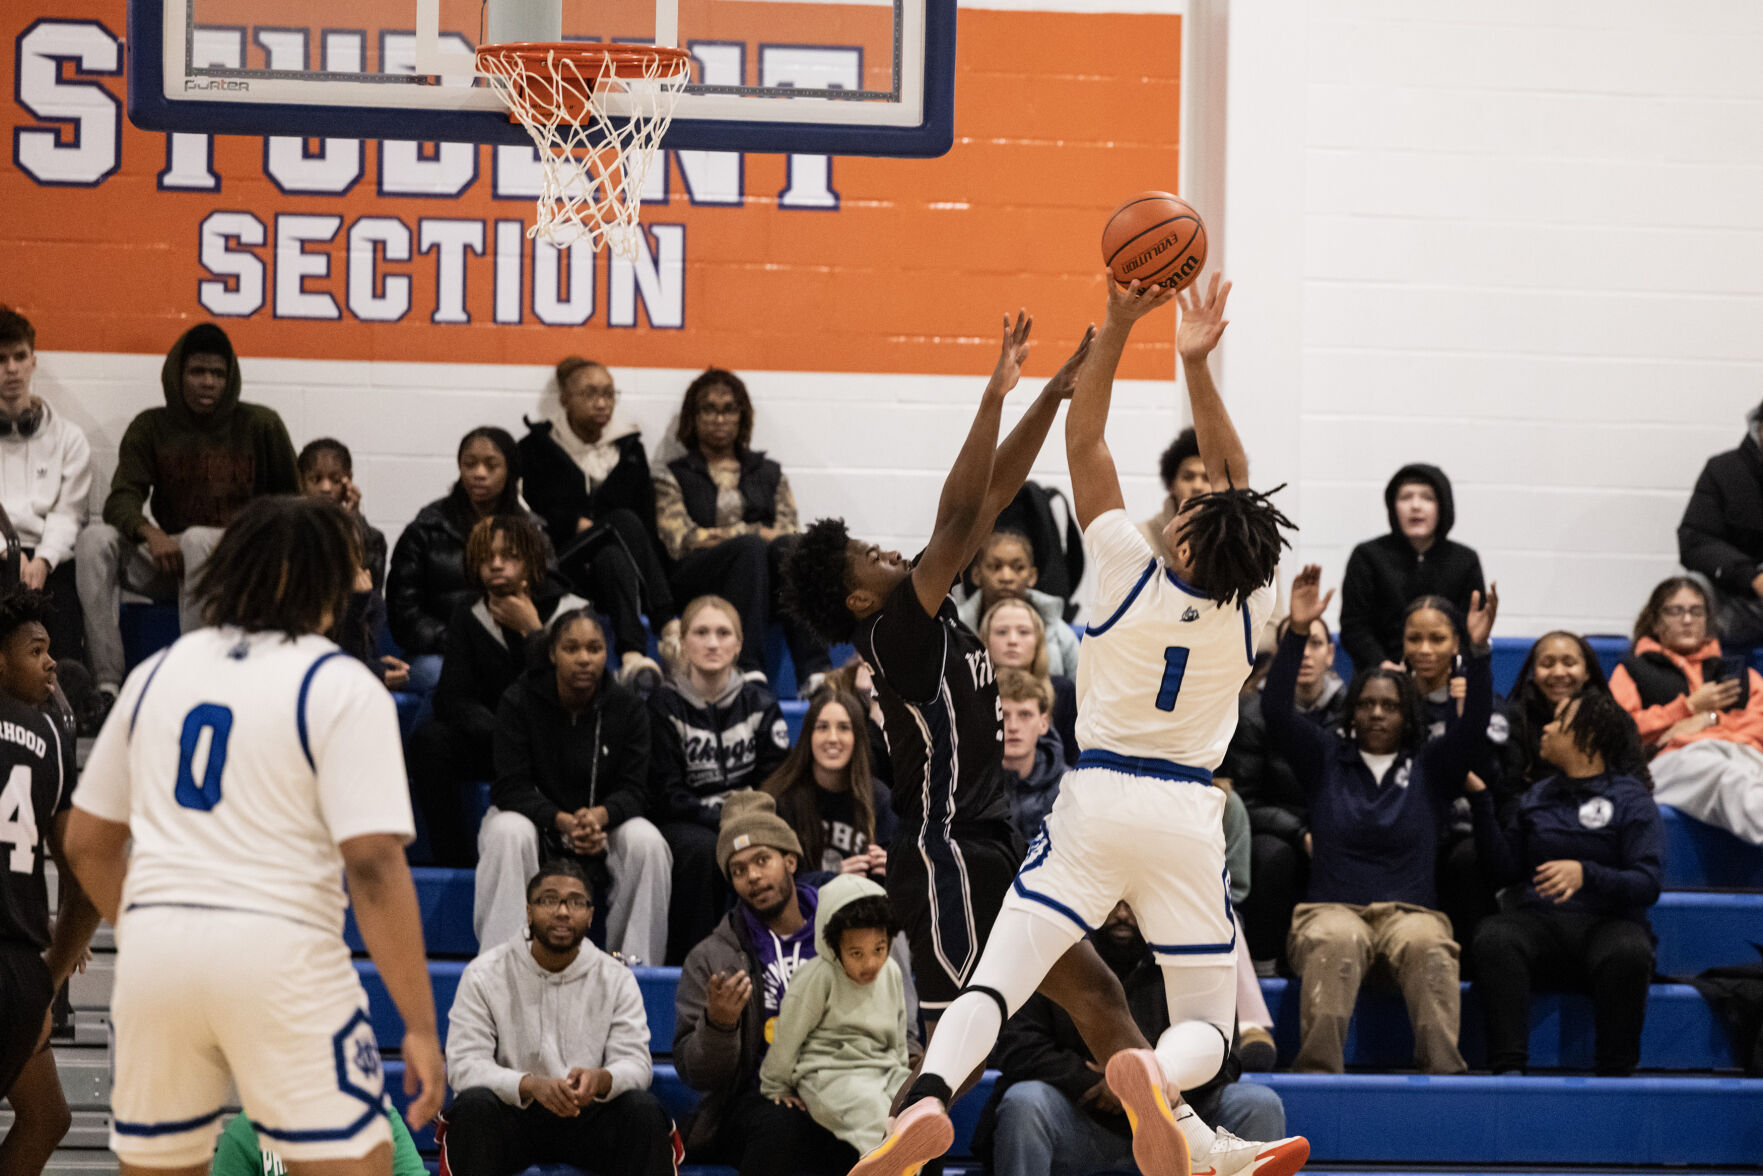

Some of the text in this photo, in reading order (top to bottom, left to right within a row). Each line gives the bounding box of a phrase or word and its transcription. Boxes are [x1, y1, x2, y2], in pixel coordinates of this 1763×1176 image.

[198, 210, 685, 329] SECTION
[1122, 233, 1178, 274] EVOLUTION
[1155, 646, 1190, 712] 1
[0, 720, 47, 759] HOOD
[175, 702, 233, 812] 0
